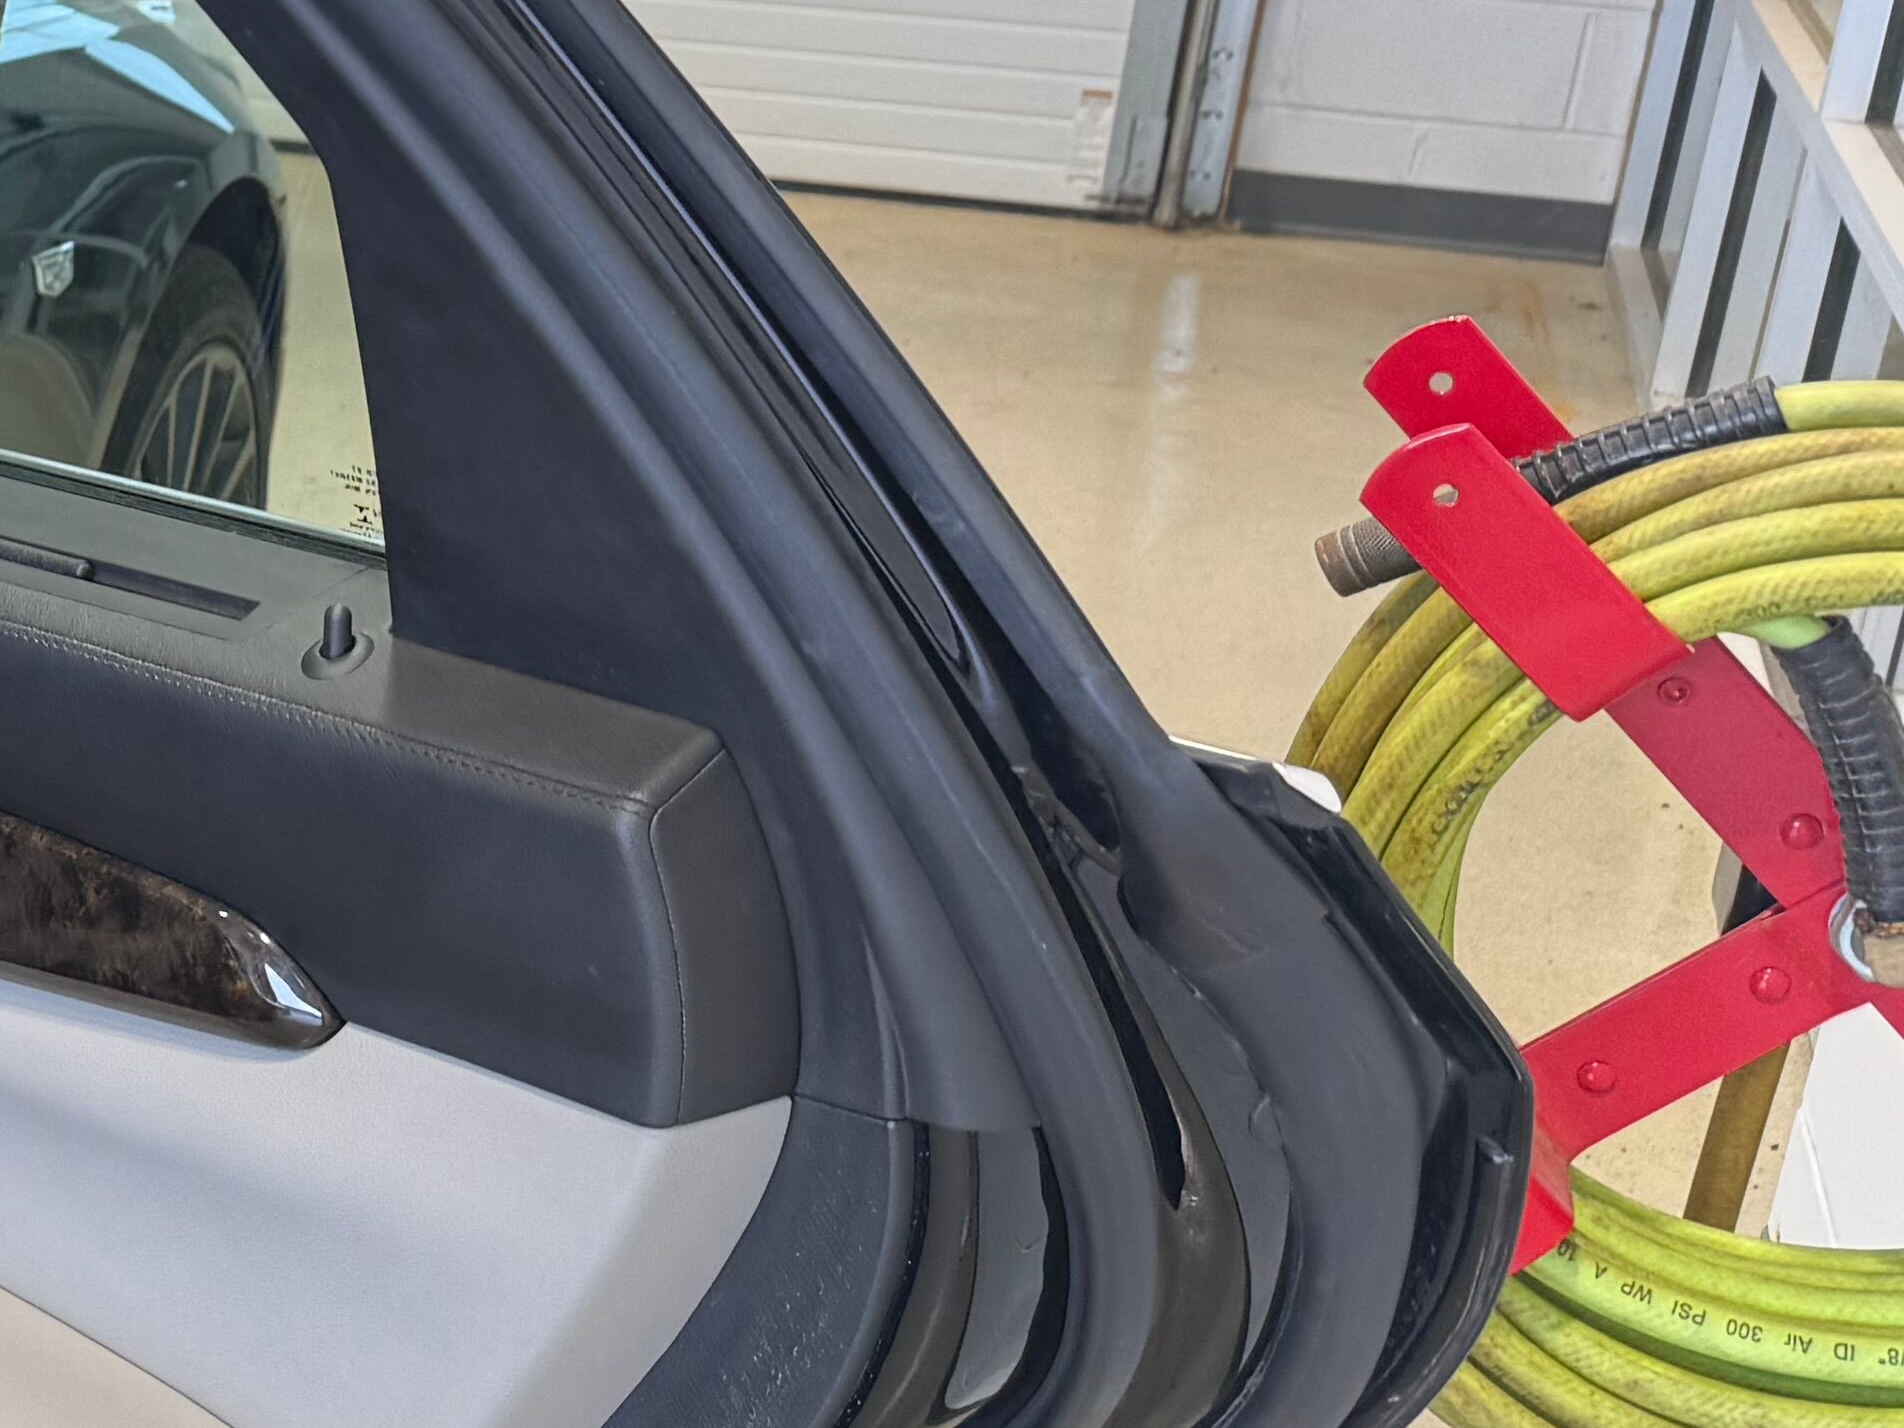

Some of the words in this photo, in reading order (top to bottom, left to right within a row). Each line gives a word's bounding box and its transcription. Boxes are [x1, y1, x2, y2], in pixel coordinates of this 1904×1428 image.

[1620, 1280, 1653, 1306] WP
[1672, 1300, 1708, 1327] PSI
[1726, 1318, 1764, 1343] 300
[1784, 1332, 1813, 1355] Air
[1833, 1342, 1856, 1361] ID
